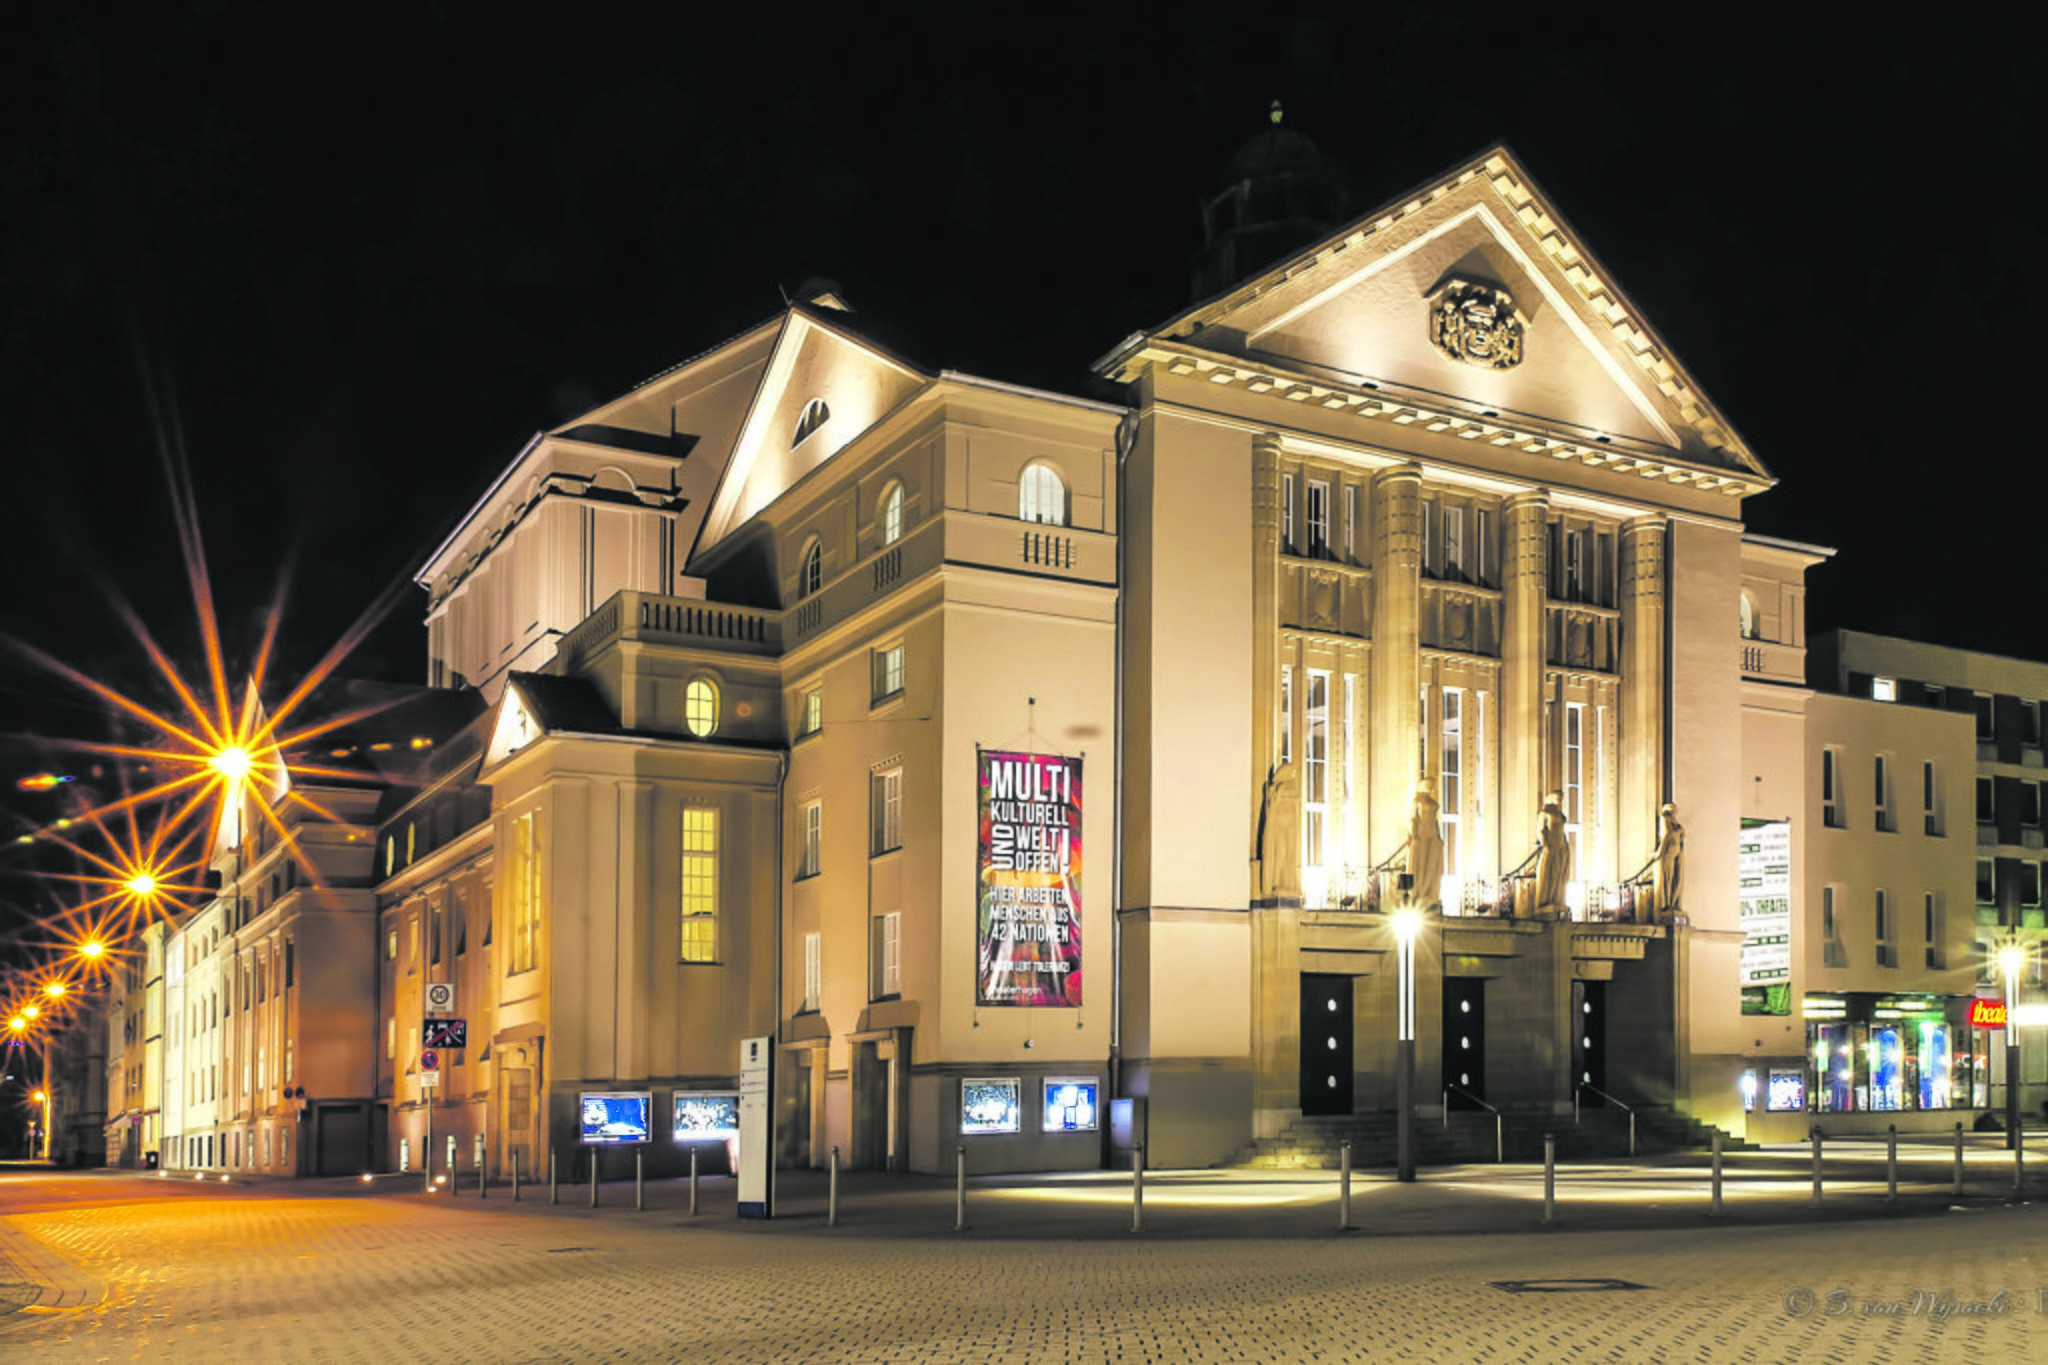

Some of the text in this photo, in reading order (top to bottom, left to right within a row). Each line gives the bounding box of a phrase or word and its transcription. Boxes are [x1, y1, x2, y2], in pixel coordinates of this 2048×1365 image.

[991, 760, 1071, 804] MULTI
[991, 800, 1070, 826] KULTURELL
[991, 824, 1015, 870] UND
[1016, 825, 1060, 851] WELT
[1015, 851, 1060, 874] OFFEN
[990, 885, 1068, 905] HIER ARBEITEN
[990, 905, 1047, 922] MENSCHEN
[991, 922, 1069, 943] 42 NATIONEN
[1973, 1001, 2008, 1023] theate
